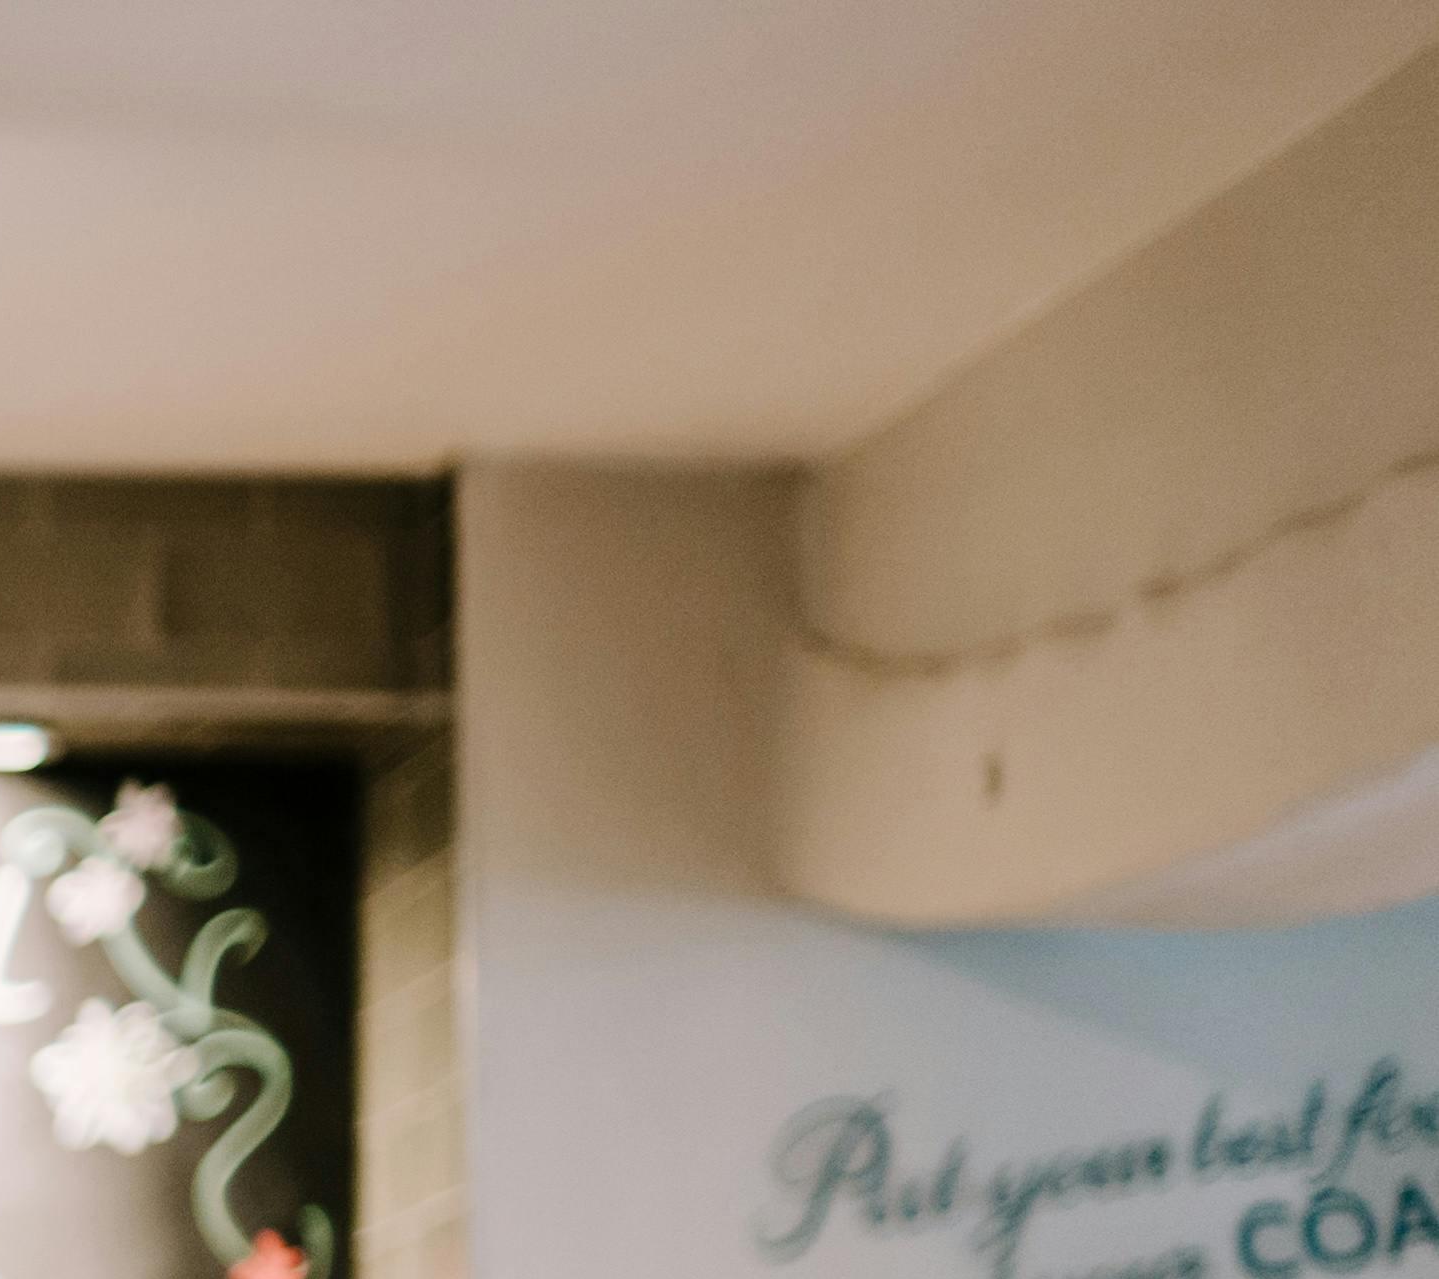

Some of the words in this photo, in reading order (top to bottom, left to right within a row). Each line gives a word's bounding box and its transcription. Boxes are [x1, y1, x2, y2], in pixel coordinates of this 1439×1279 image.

[749, 1093, 967, 1267] Put
[972, 1138, 1174, 1262] your
[1190, 1078, 1327, 1180] best
